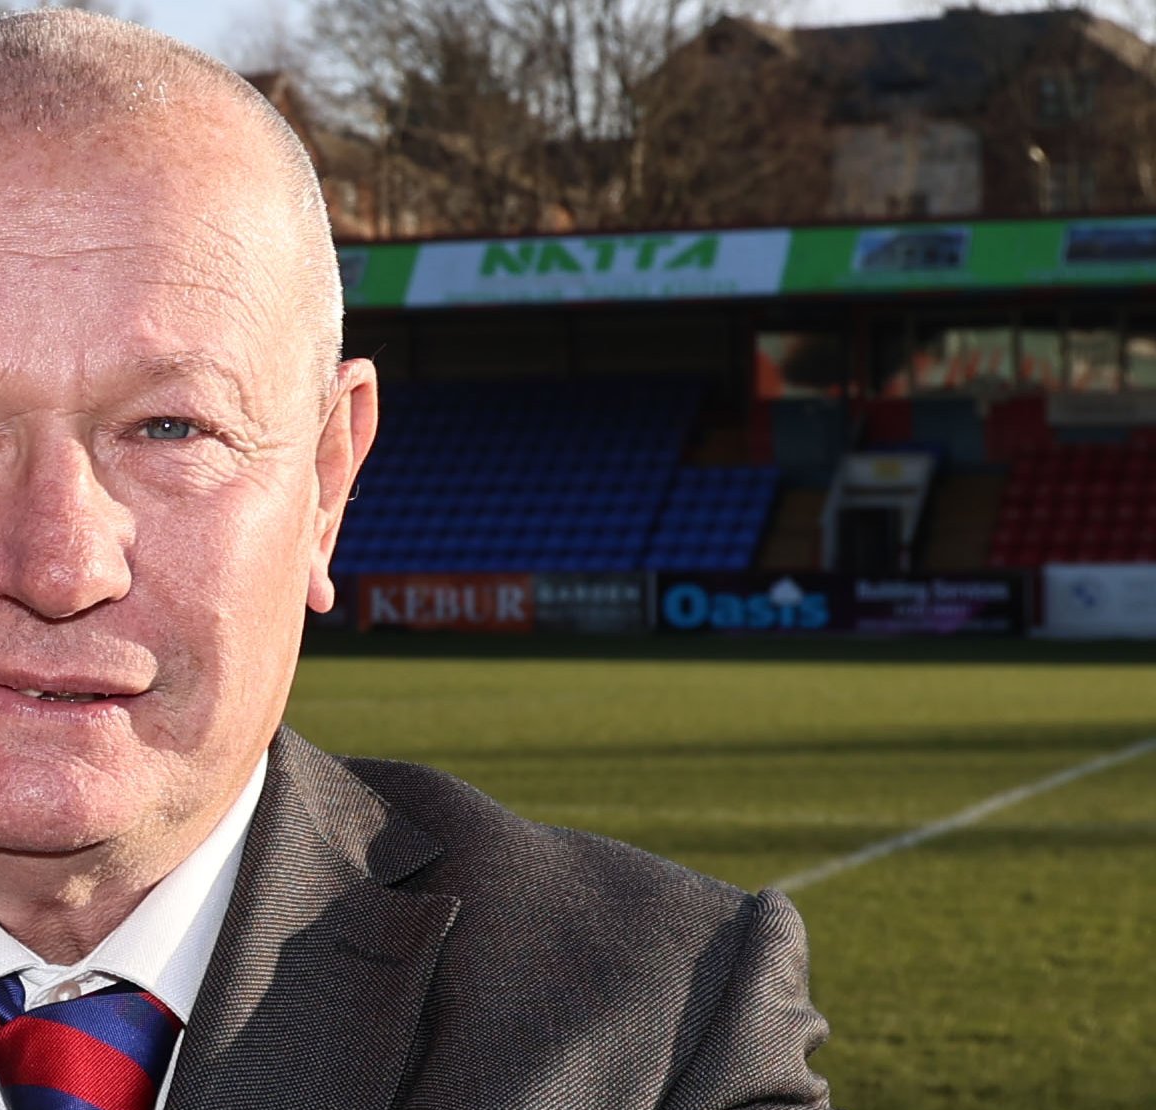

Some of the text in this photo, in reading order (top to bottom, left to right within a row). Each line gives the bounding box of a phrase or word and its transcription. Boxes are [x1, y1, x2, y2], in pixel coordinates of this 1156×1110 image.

[480, 232, 721, 275] NATTA
[369, 585, 526, 623] KEBUR
[663, 581, 829, 629] Oasis
